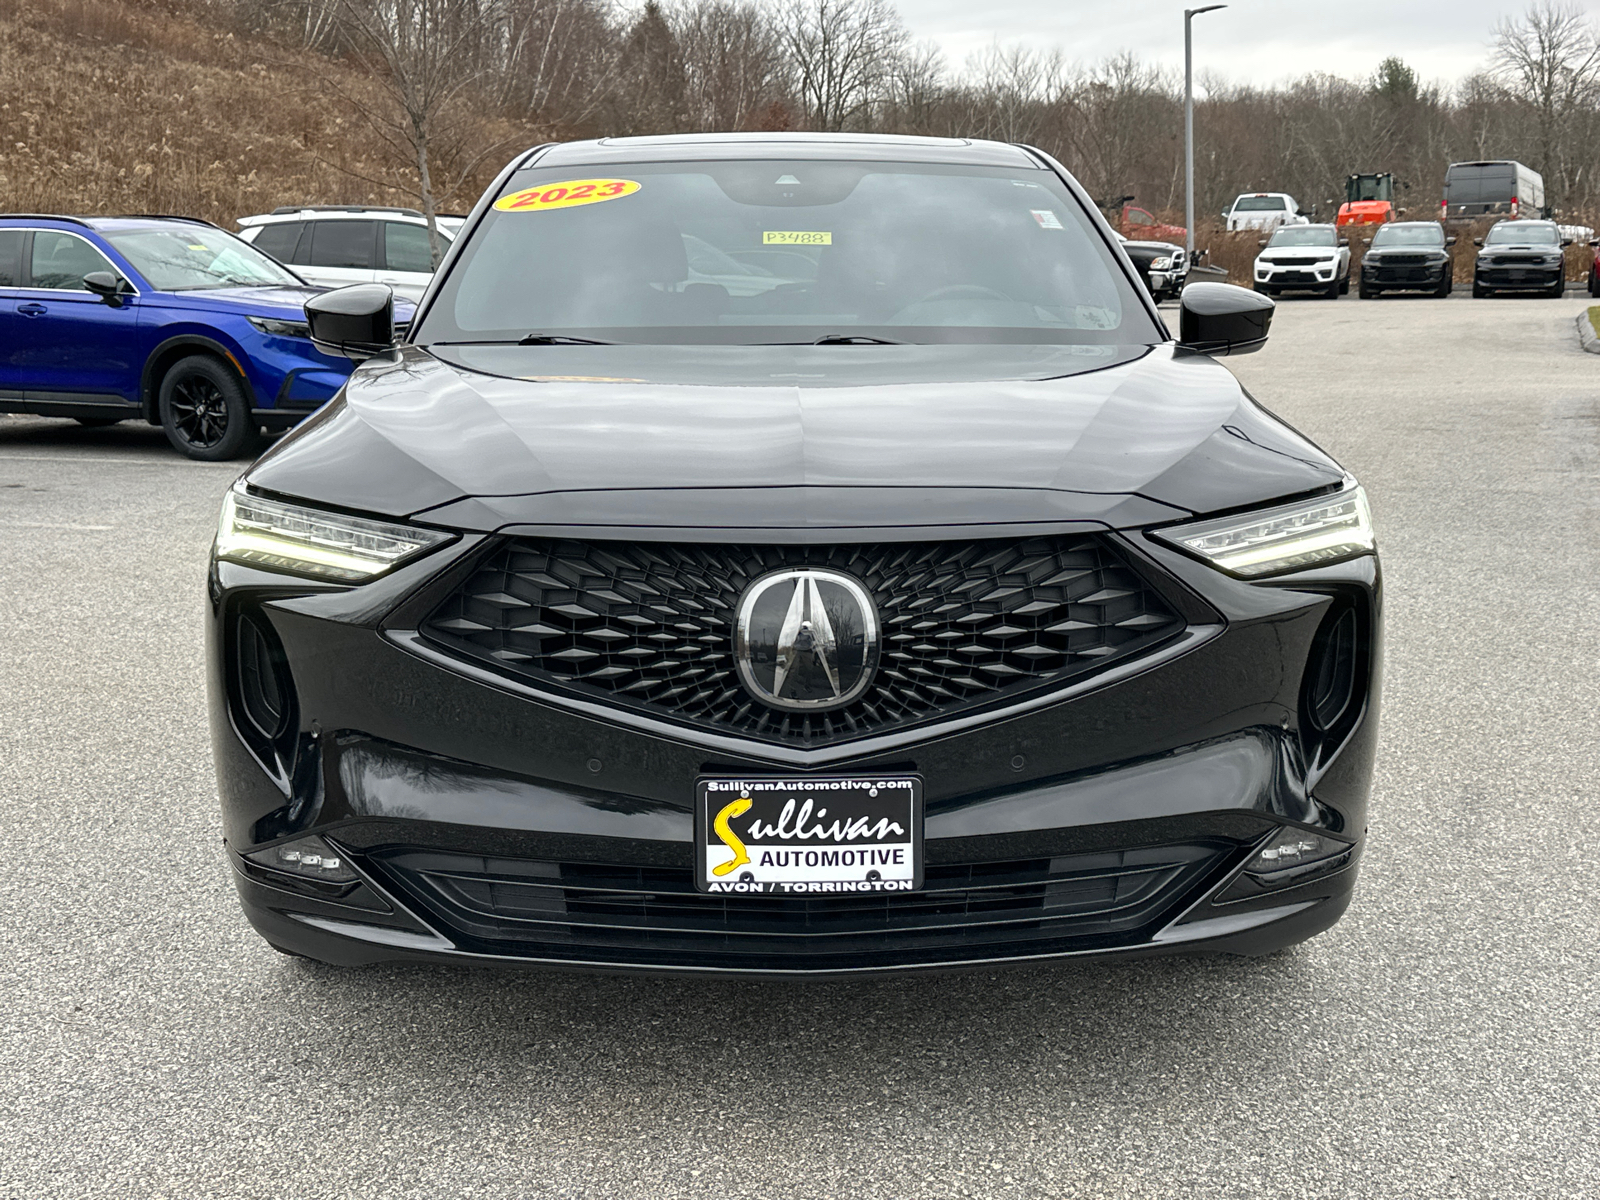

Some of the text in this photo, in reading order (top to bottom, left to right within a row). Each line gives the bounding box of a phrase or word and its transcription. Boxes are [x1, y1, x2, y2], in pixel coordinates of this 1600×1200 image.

[509, 182, 626, 209] 2023
[707, 780, 913, 792] SullivanAutomotive.com
[712, 797, 905, 877] Sullivan
[759, 848, 905, 867] AUTOMOTIVE
[707, 881, 764, 893] AVON
[780, 880, 913, 893] TORRINGTON
